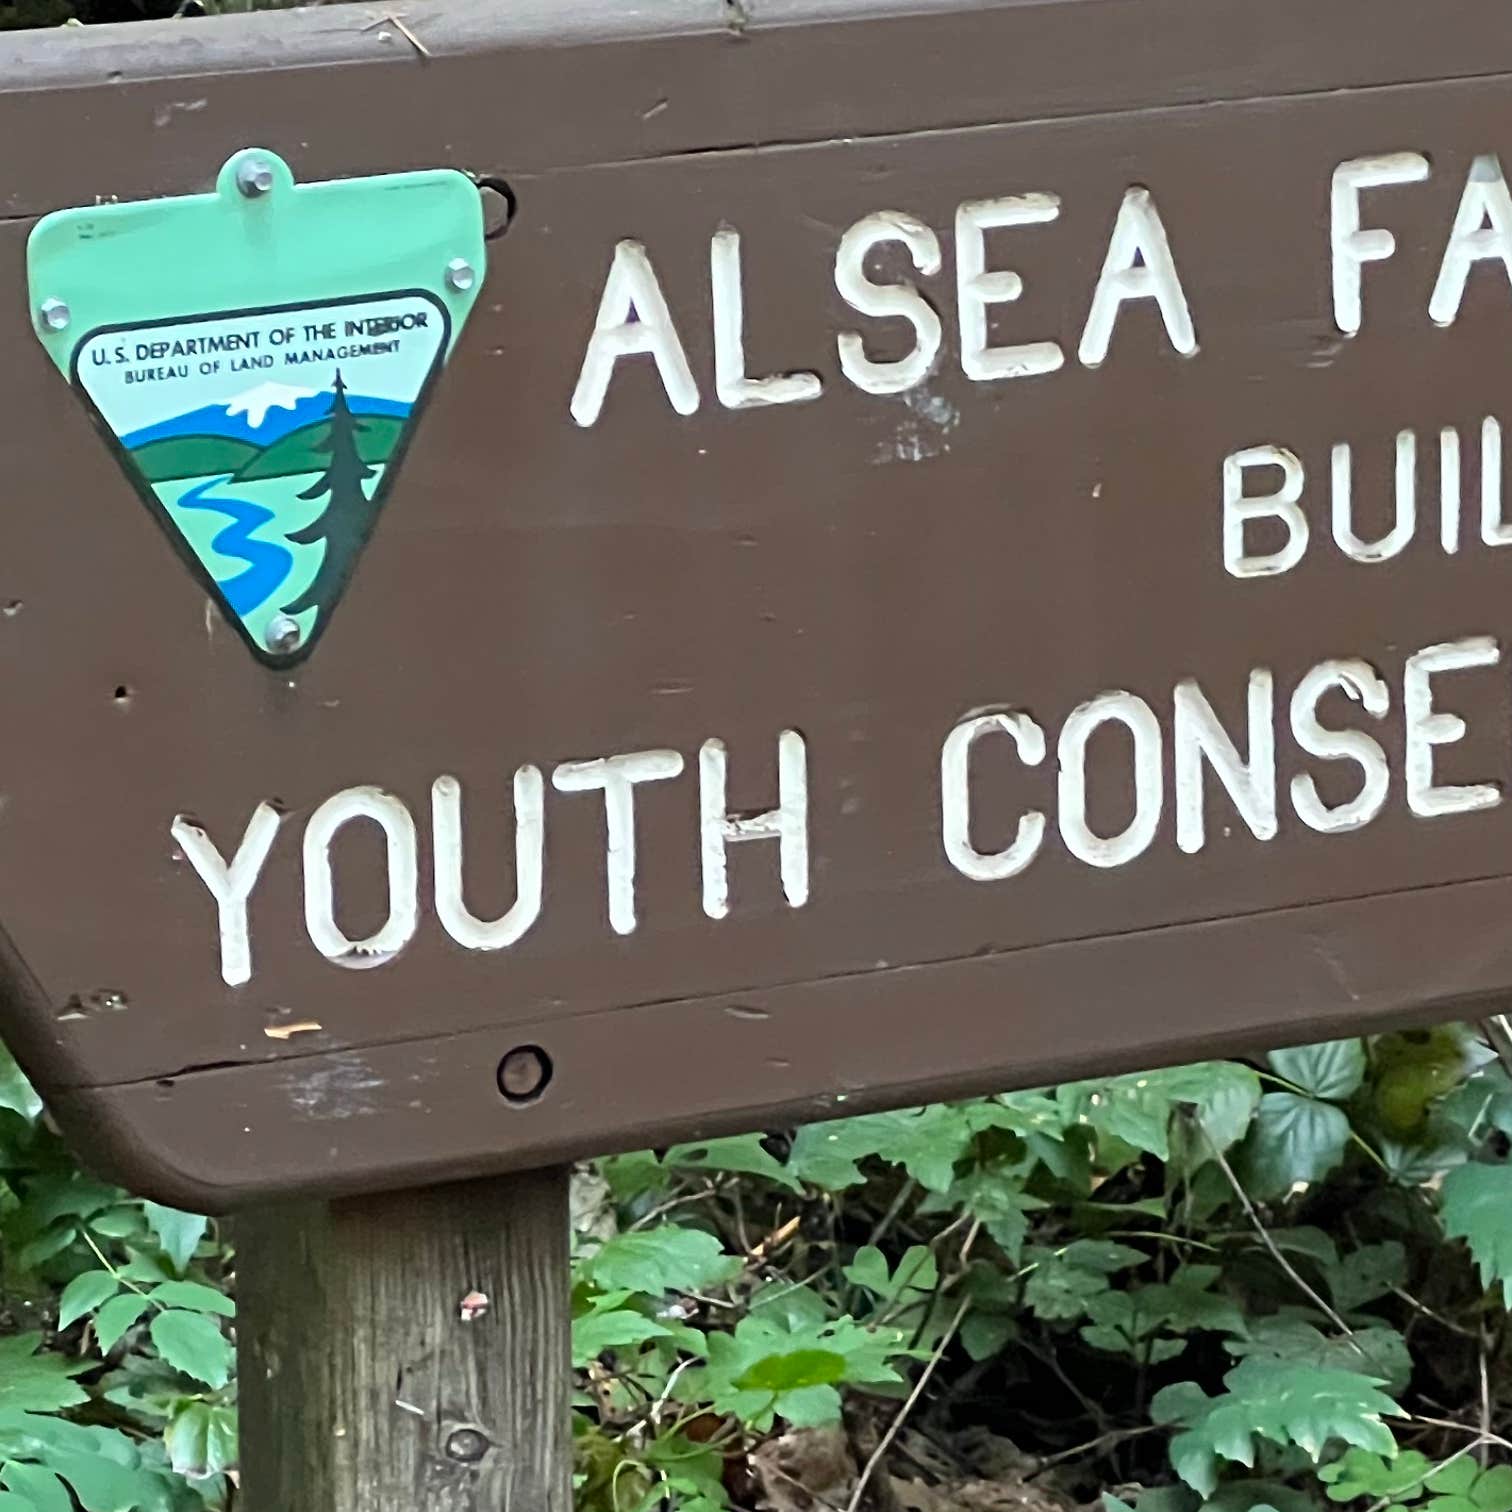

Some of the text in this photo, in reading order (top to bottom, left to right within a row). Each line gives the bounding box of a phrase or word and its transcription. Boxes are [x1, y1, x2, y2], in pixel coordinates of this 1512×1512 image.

[124, 339, 401, 384] BUREAU OF LAND MANAGEMENT
[135, 331, 260, 361] DEPARTMENT
[269, 327, 295, 345] OF
[303, 322, 337, 341] THE
[568, 188, 1201, 429] ALSEA
[169, 728, 811, 988] YOUTH
